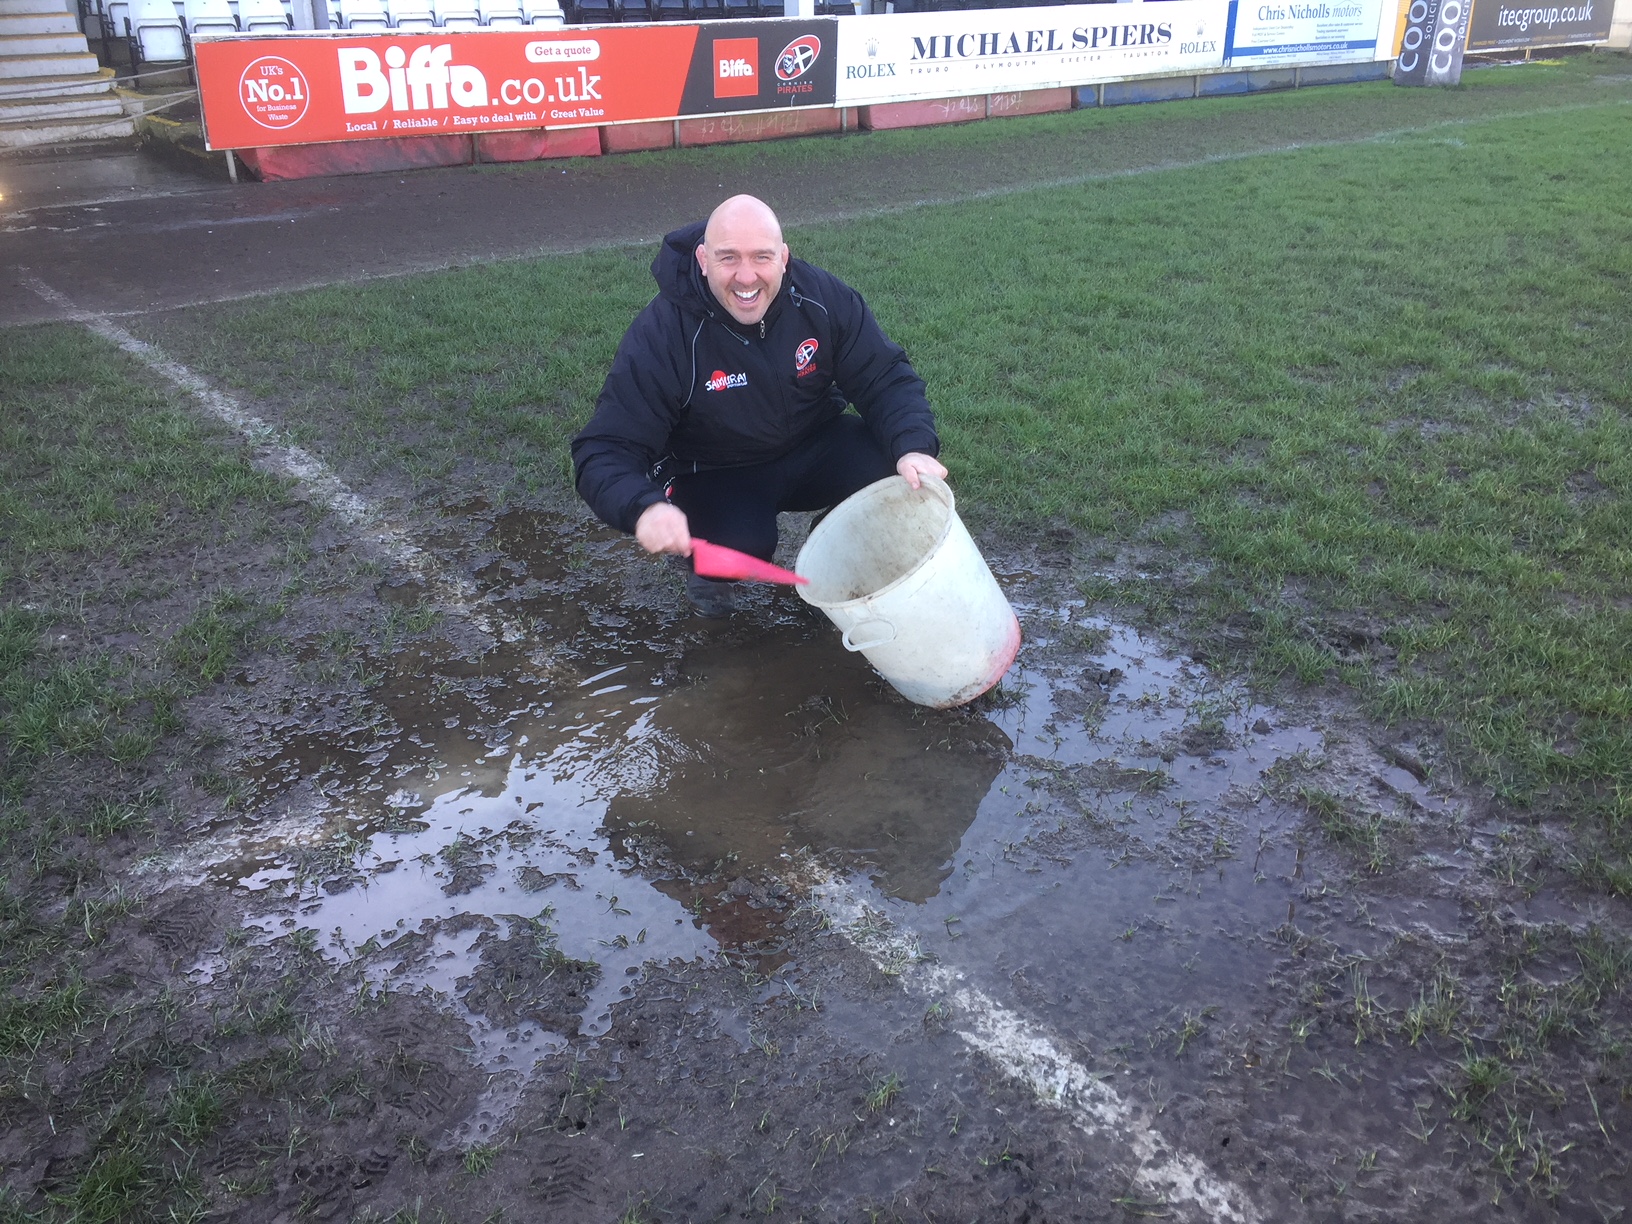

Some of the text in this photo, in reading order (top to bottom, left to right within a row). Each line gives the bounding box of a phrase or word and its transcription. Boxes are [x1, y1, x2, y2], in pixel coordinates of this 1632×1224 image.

[1258, 3, 1363, 21] Chris Nicholls motors
[1424, 0, 1438, 40] SOLICI
[1498, 0, 1593, 31] itecgroup.co.uk
[910, 22, 1172, 60] MICHAEL SPIERS
[1179, 41, 1217, 54] ROLEX
[534, 46, 553, 56] Get
[564, 46, 591, 57] quote
[260, 65, 283, 76] UK's
[719, 58, 754, 78] Biffa
[846, 62, 896, 79] ROLEX
[910, 50, 1169, 74] TRURO PLYMOUTH EXETER TAUNTON
[244, 77, 304, 103] No.1
[777, 84, 813, 94] PIRATES
[345, 121, 377, 132] Local
[392, 117, 438, 129] Reliable
[453, 115, 478, 126] Easy
[480, 114, 490, 123] to
[491, 113, 513, 123] deal
[515, 111, 537, 121] with
[550, 109, 577, 119] Great
[578, 107, 605, 117] Value
[705, 372, 747, 391] SAMURAI
